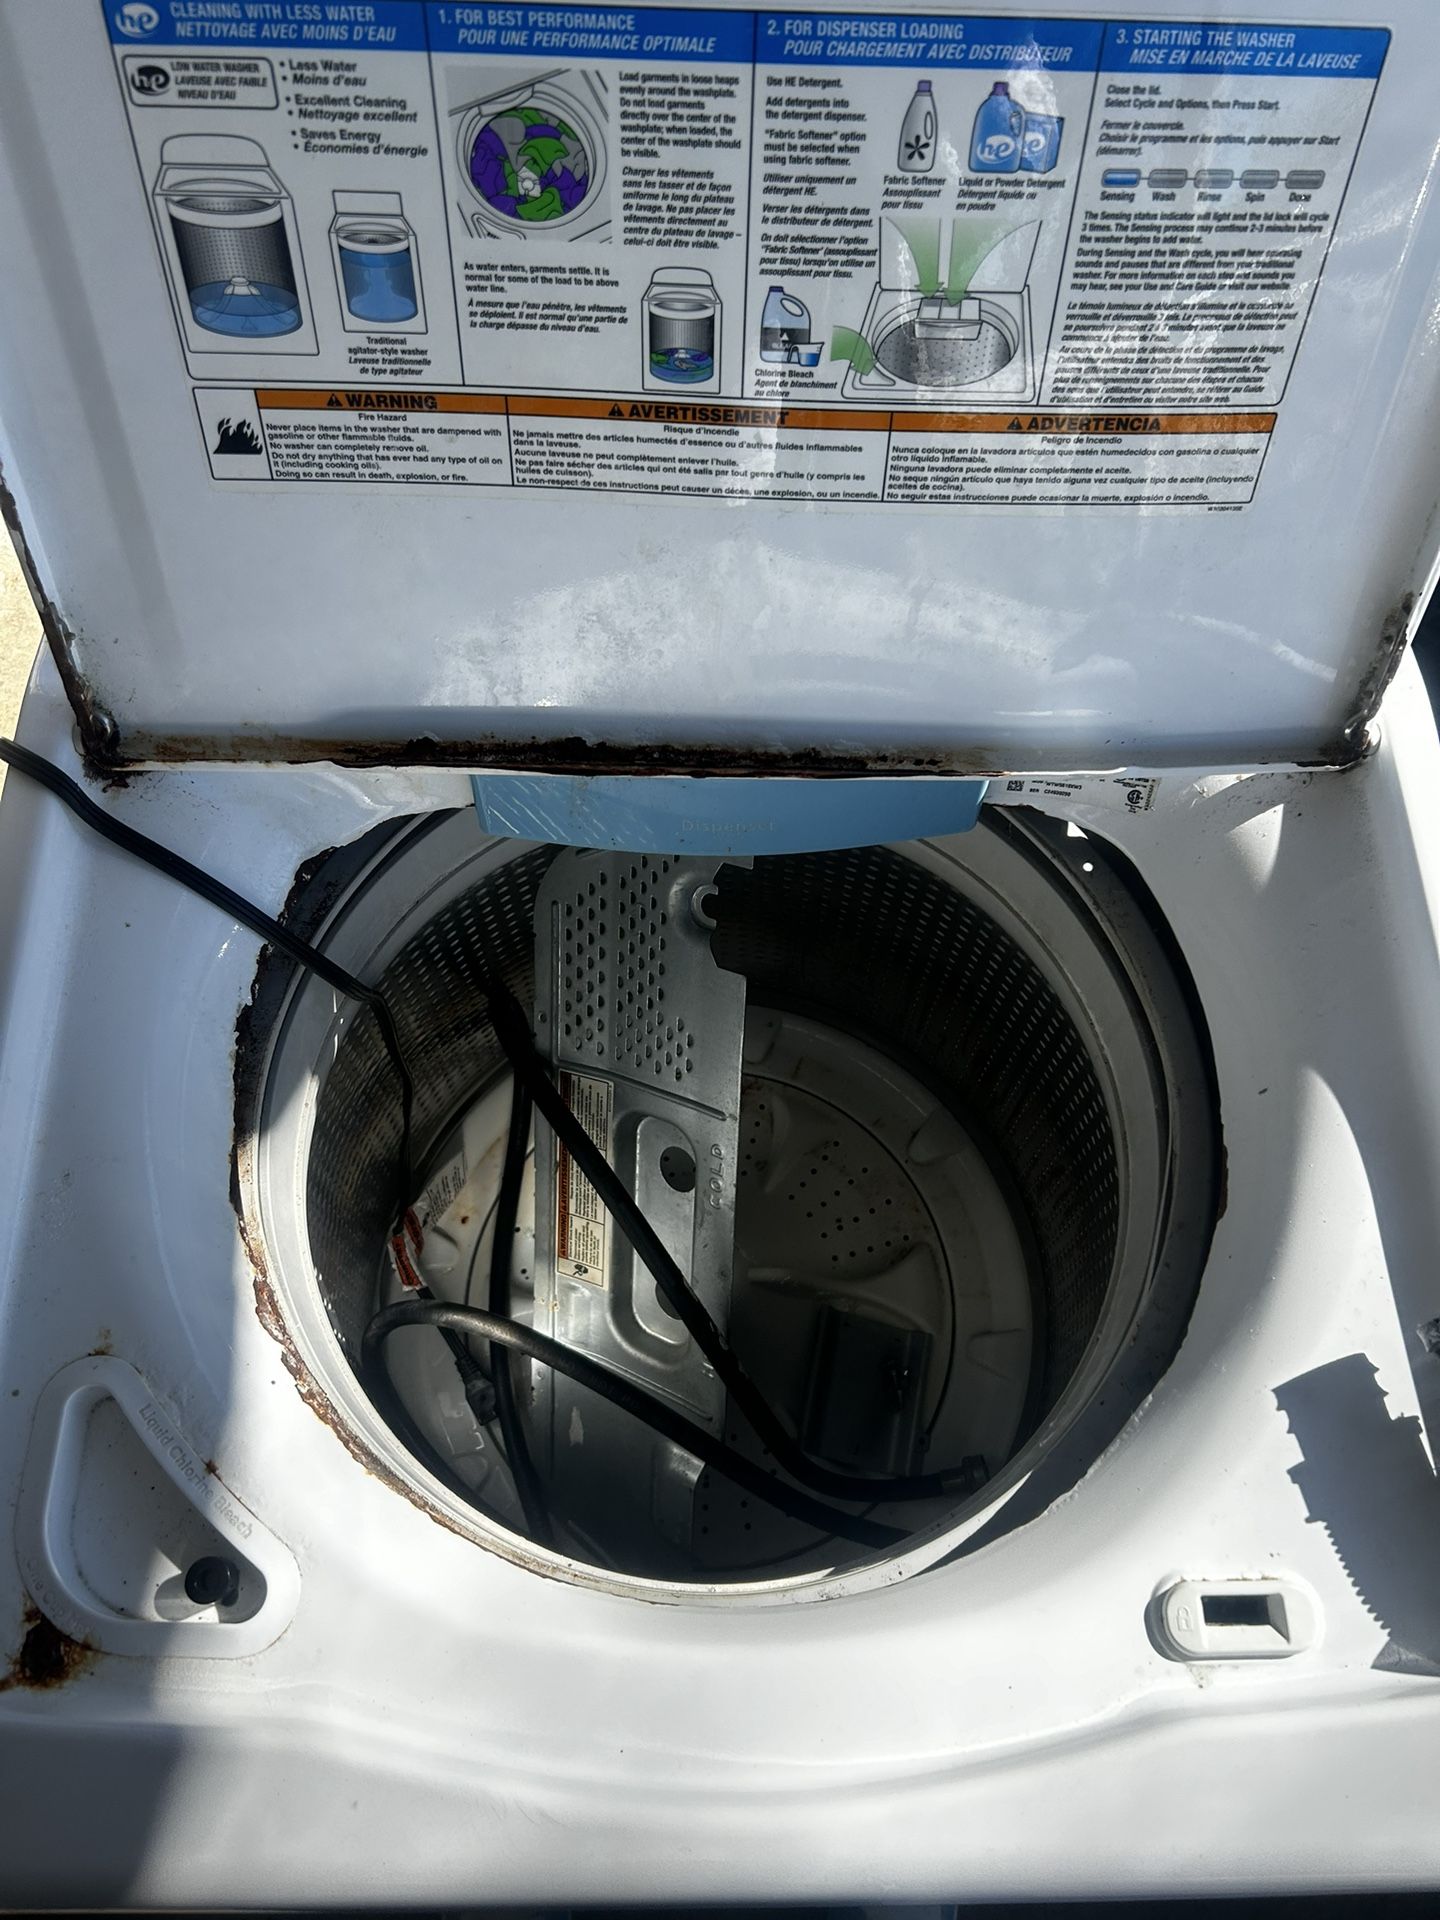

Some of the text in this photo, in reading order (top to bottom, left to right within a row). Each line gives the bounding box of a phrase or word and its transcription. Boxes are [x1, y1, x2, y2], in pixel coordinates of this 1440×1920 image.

[169, 2, 374, 21] CLEANING WITH LESS WATER
[439, 8, 634, 30] 1. FOR BEST PERFORMANCE
[176, 21, 396, 41] NETTOYAGE AVEC MOINS D'EAU
[767, 19, 963, 39] 2. FOR DISPENSER LOADING
[458, 28, 716, 52] POUR UNE PERFORMANCE OPTIMALE
[1116, 28, 1295, 48] 3. STARTING THE WASHER
[784, 39, 1072, 63] POUR CHARGEMENT AVEC DISTRIBUTEUR
[288, 58, 356, 72] Less Water
[1129, 48, 1361, 69] MISE EN MARCHE DE LA LAVEUSE
[292, 72, 366, 86] Moins d'eau
[619, 71, 739, 86] Load garments in loose heaps
[766, 76, 782, 86] Use
[784, 76, 796, 86] HE
[619, 85, 646, 97] evenly
[647, 86, 675, 96] around
[677, 86, 690, 96] the
[294, 93, 406, 111] Excellent Cleaning
[765, 96, 849, 109] Add detergents into
[298, 107, 417, 122] Nettoyage excellent
[765, 109, 779, 119] the
[781, 110, 822, 122] detergent
[300, 127, 382, 144] Saves Energy
[839, 131, 866, 142] option
[304, 139, 428, 158] Économies d'énergie
[764, 142, 860, 153] must be selected when
[763, 154, 786, 166] using
[788, 154, 812, 164] fabric
[883, 174, 946, 185] Fabric Softener
[958, 176, 983, 188] Liquid
[994, 177, 1025, 187] Powder
[1026, 177, 1065, 189] Detergent
[882, 187, 941, 198] Assouplissant
[1100, 190, 1135, 203] Sensing
[1152, 191, 1175, 201] Wash
[1245, 191, 1265, 203] Spin
[880, 200, 901, 210] pour
[366, 336, 406, 345] Traditional
[348, 346, 398, 356] agitator-style
[348, 356, 431, 366] Laveuse traditionnelle
[371, 366, 387, 376] type
[389, 367, 423, 376] agitateur
[755, 368, 813, 378] Chlorine Bleach
[789, 380, 837, 389] blanchiment
[346, 394, 438, 409] WARNING
[358, 412, 406, 421] Fire Hazard
[628, 407, 789, 425] AVERTISSEMENT
[663, 424, 739, 436] Risque d'incendie
[1026, 417, 1161, 431] ADVERTENCIA
[1040, 435, 1122, 445] Peligro de Incendio
[334, 443, 380, 452] completely
[514, 448, 547, 457] Aucune
[548, 449, 580, 458] laveuse
[595, 452, 614, 460] peut
[616, 454, 675, 463] complètement
[678, 456, 709, 465] enlever
[890, 464, 925, 475] Ninguna
[927, 464, 963, 472] lavadora
[965, 465, 991, 474] puede
[1029, 466, 1093, 475] completamente
[709, 1144, 724, 1209] COLD
[560, 1214, 568, 1250] WARNING
[138, 1405, 253, 1540] Liquid Chlorine Bleach
